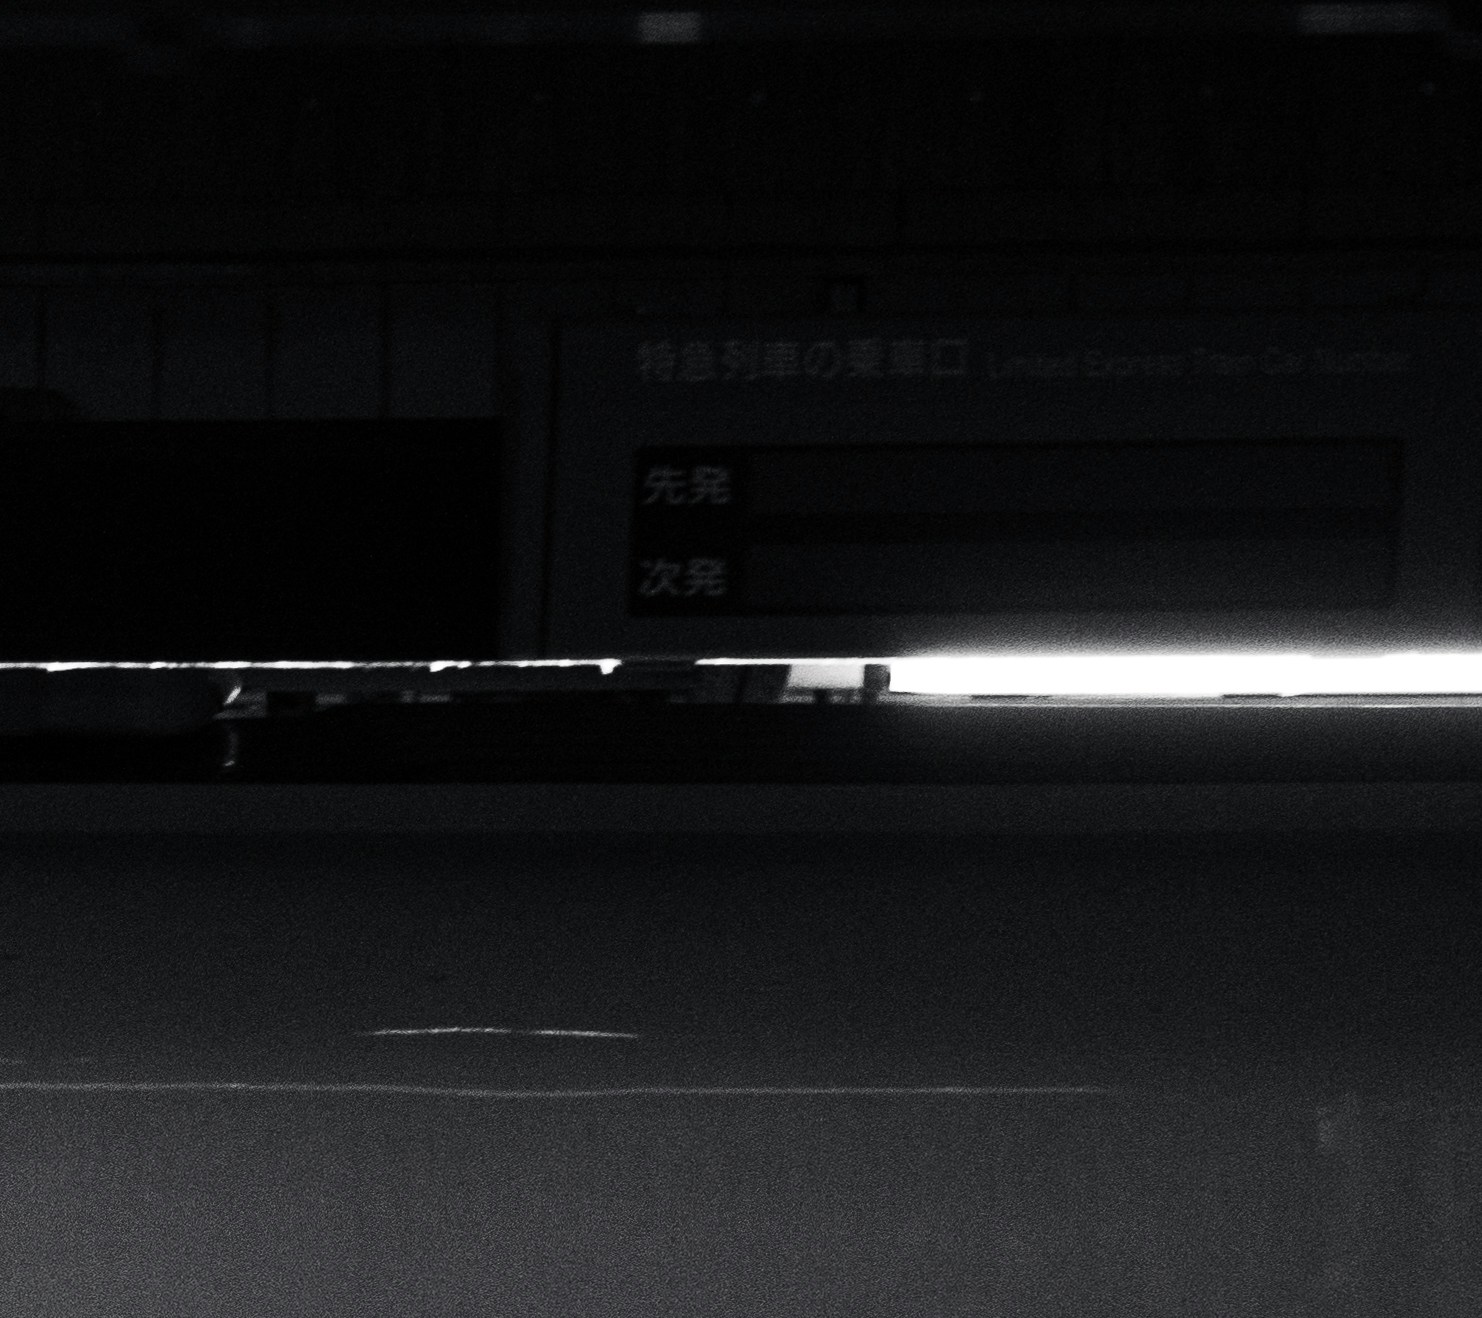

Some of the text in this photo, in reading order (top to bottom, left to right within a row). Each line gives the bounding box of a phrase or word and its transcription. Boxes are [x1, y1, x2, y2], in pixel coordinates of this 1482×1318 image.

[636, 338, 968, 382] 特急列車の乗車口
[642, 459, 731, 505] 先発
[638, 556, 727, 599] 次発
